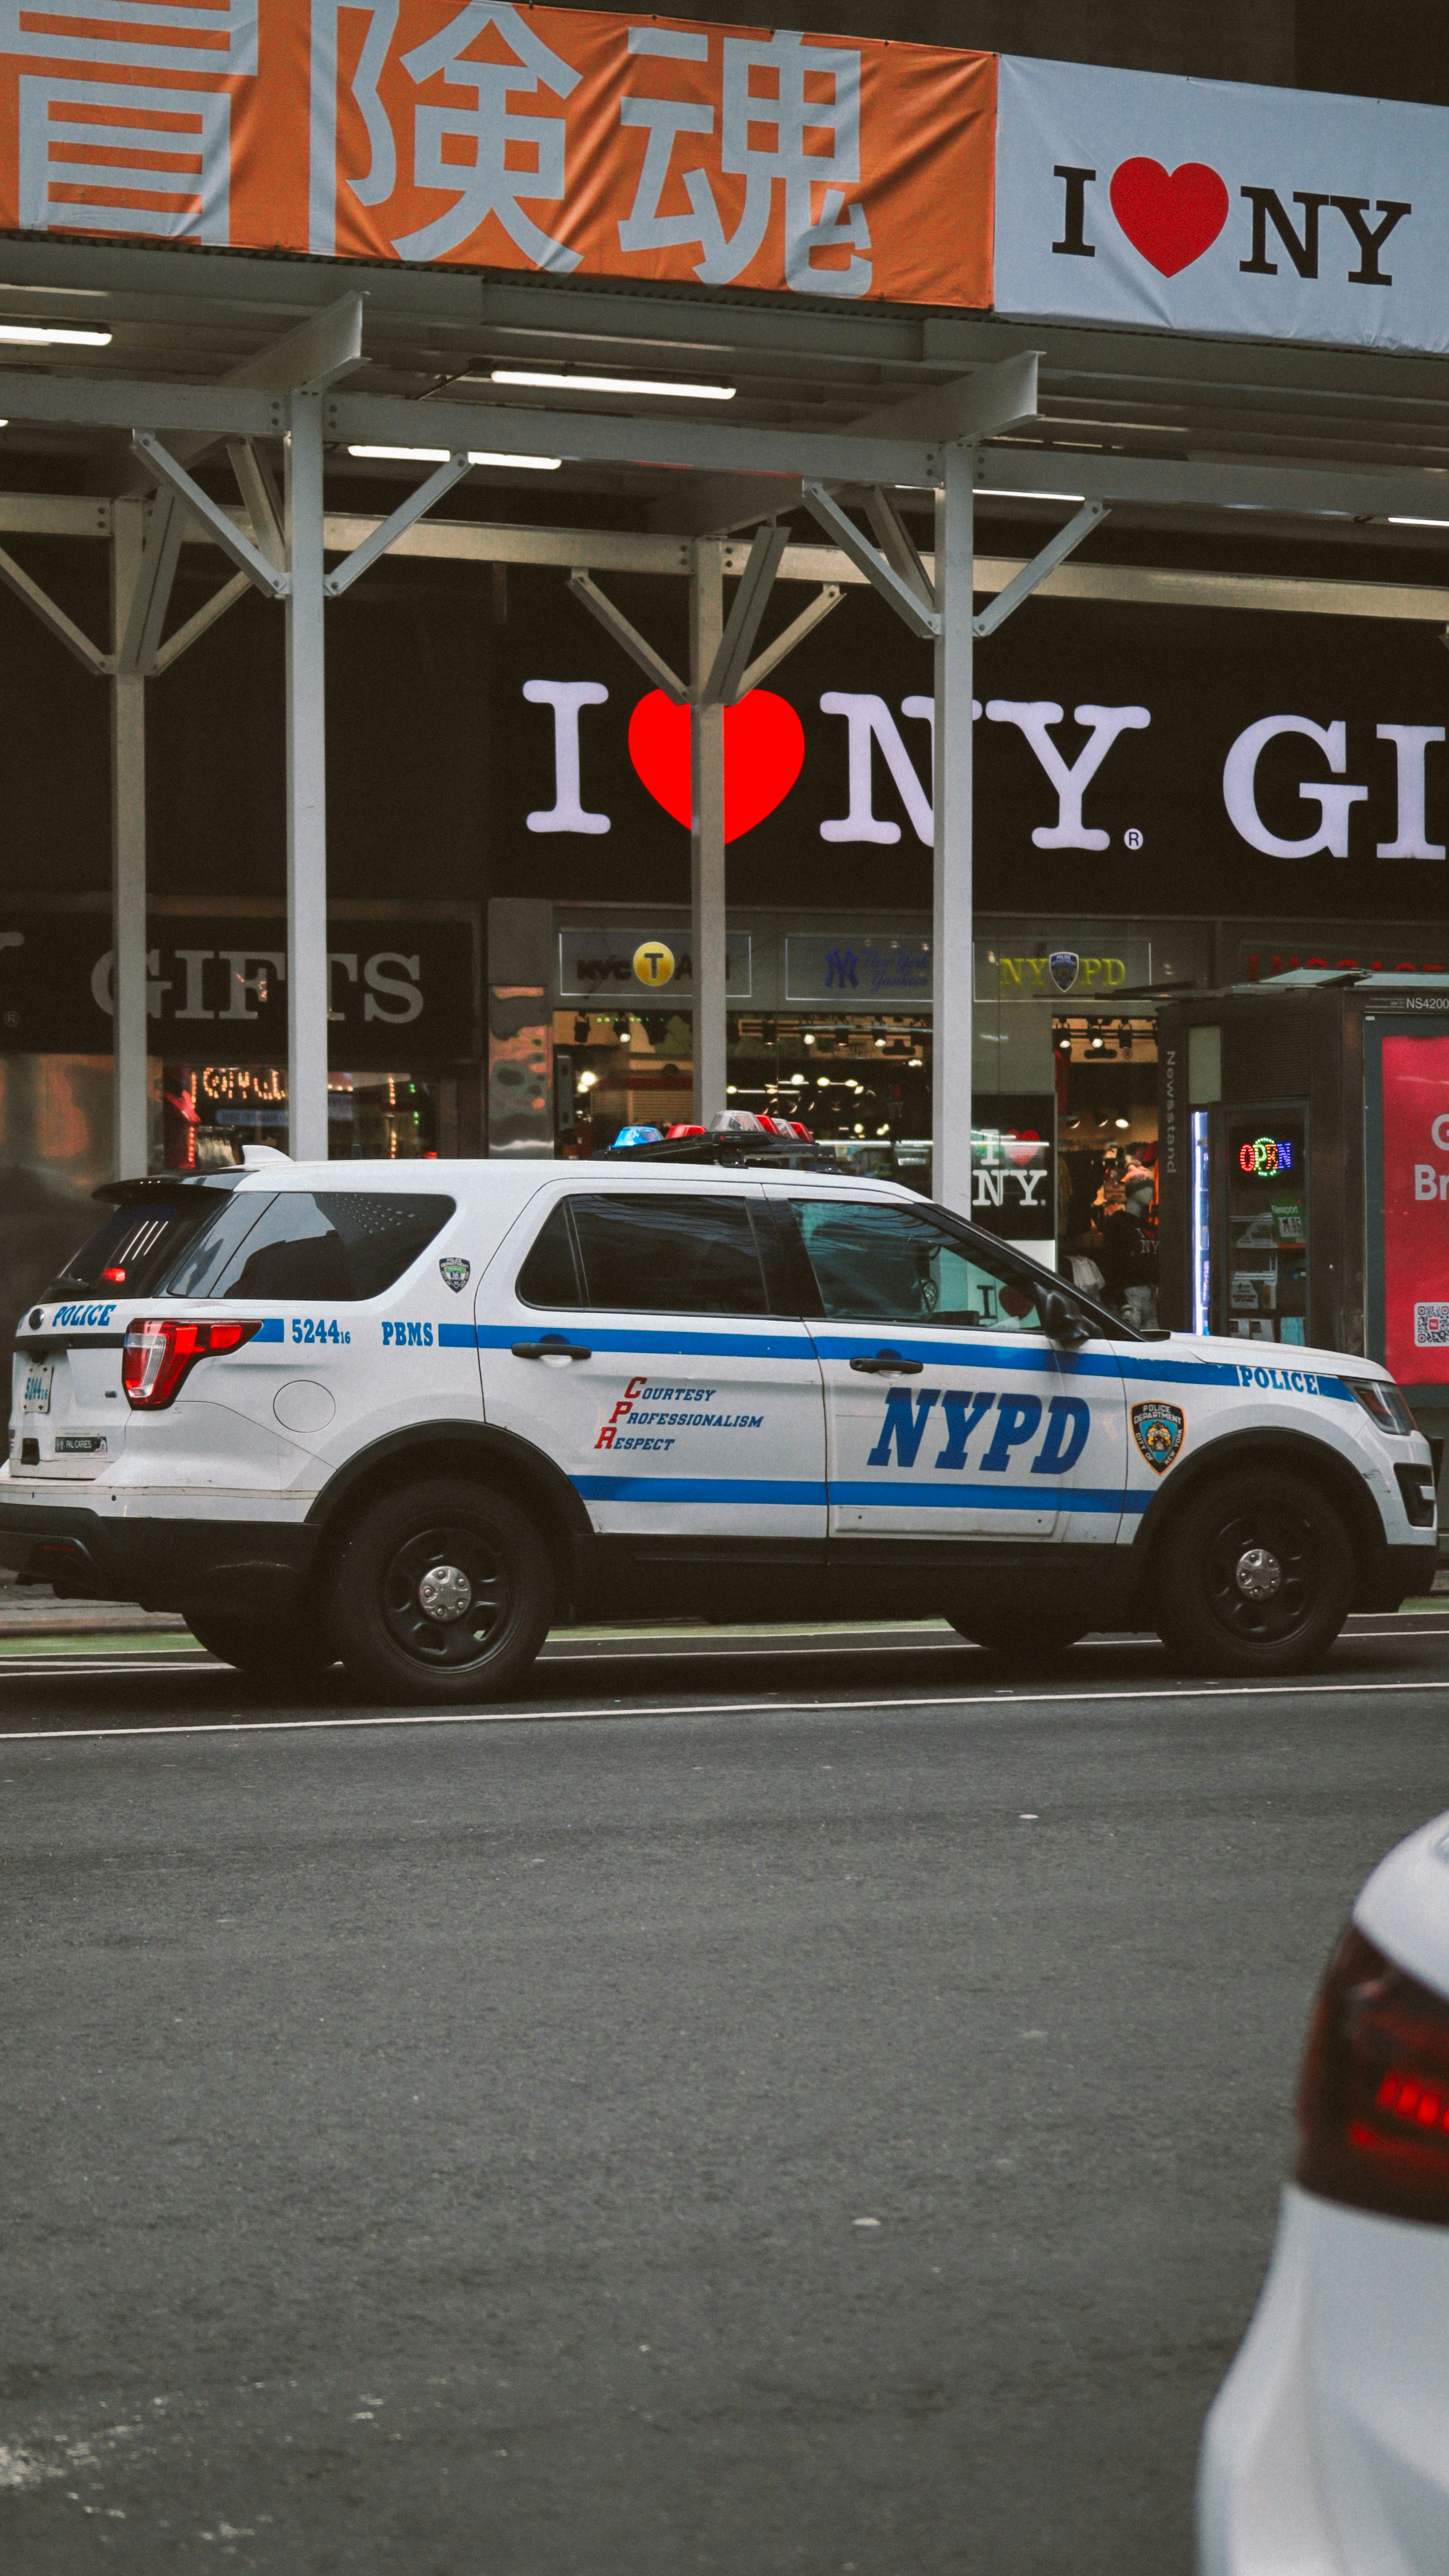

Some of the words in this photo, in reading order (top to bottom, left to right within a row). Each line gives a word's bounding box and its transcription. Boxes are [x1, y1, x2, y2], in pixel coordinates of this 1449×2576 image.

[1052, 164, 1096, 258] I
[1238, 185, 1412, 286] NY
[523, 680, 611, 834] I
[1222, 714, 1447, 860] GI
[644, 952, 730, 981] TAI
[1167, 1050, 1176, 1173] Newsstand
[980, 1129, 1000, 1165] I
[52, 1304, 117, 1327] POLICE
[382, 1322, 434, 1347] PBMS
[624, 1376, 716, 1401] COURTESY
[1239, 1367, 1319, 1396] POLICE
[608, 1401, 765, 1428] PROFESSIONALISM
[1133, 1411, 1182, 1424] DEPARTMENT
[1143, 1404, 1171, 1413] POLICE
[75, 1440, 92, 1449] CARES
[594, 1426, 675, 1450] RESPECT
[867, 1387, 1090, 1475] NYPD
[1136, 1433, 1147, 1449] CITY
[1145, 1452, 1155, 1461] OF
[1164, 1450, 1176, 1465] NEW
[1173, 1429, 1183, 1447] YORK
